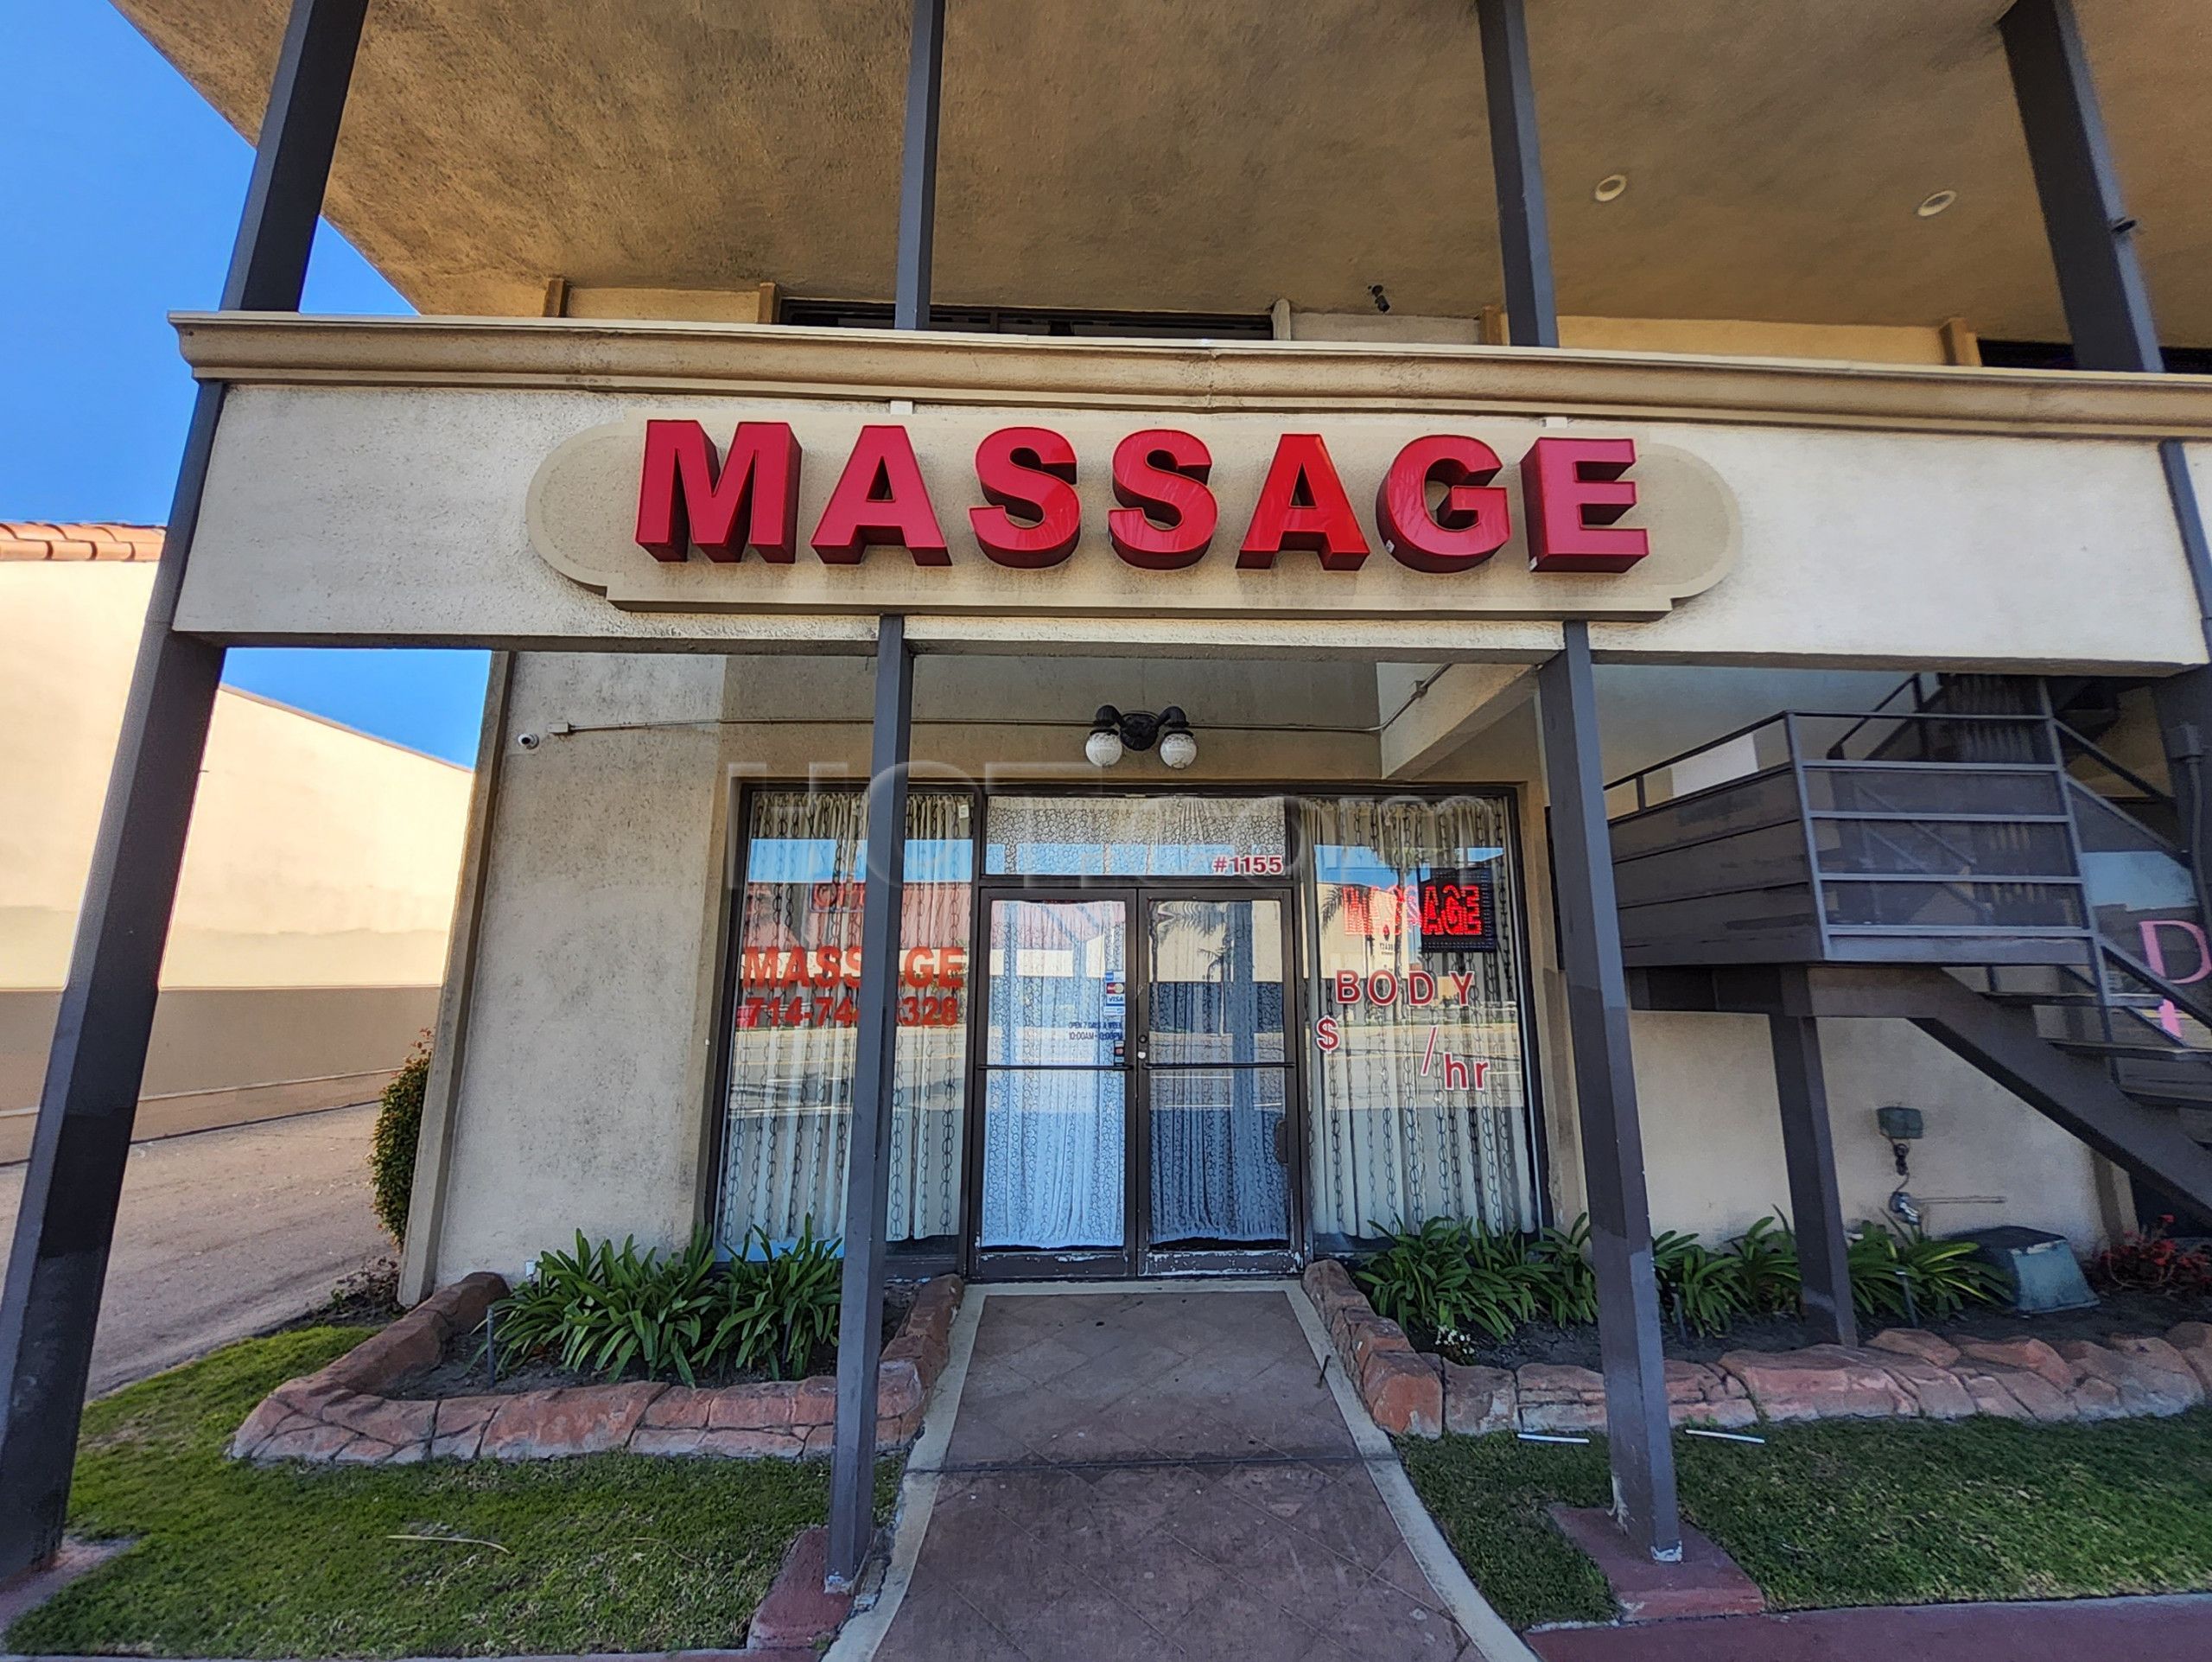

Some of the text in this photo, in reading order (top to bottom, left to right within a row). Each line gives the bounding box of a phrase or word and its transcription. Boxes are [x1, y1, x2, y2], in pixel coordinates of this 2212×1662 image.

[635, 419, 1649, 574] MASSAGE
[1212, 855, 1284, 874] #1155
[743, 946, 965, 989] MASSGE
[1336, 969, 1475, 1006] BODY
[746, 997, 959, 1027] 714-74328
[1316, 1016, 1340, 1054] $
